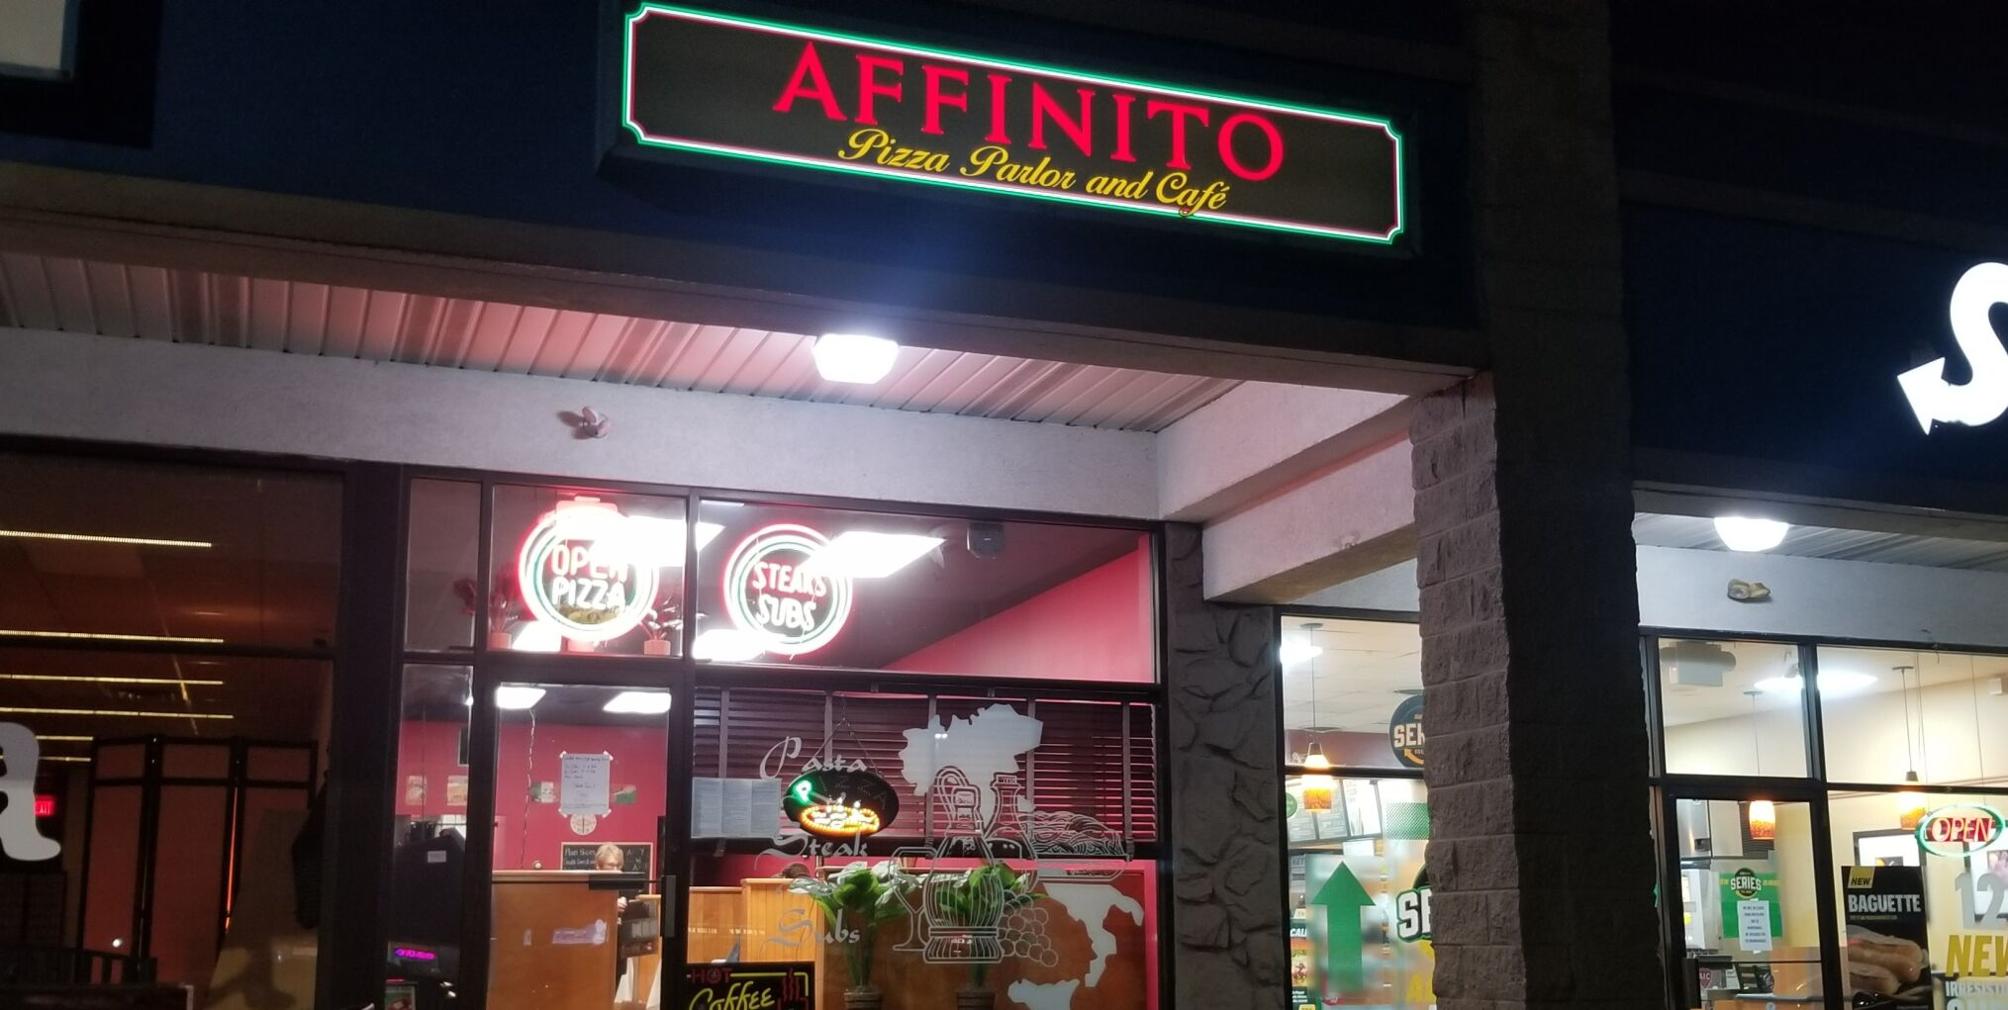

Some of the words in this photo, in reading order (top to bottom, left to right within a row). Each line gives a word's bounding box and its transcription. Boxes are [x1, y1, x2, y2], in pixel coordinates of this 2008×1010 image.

[773, 41, 1284, 181] AFFINITO
[838, 128, 953, 172] Pizza
[960, 145, 1079, 189] Parlor
[1086, 171, 1153, 199] and
[1156, 172, 1232, 217] Café
[551, 577, 626, 613] PIZZA
[756, 594, 817, 631] SUBS
[760, 736, 868, 780] Pasta
[757, 824, 868, 866] Steak
[1932, 817, 1992, 842] OPEN
[1730, 876, 1762, 890] SERIES
[1851, 878, 1871, 886] NEW
[1848, 894, 1922, 912] BAGUETTE
[762, 908, 861, 949] Subs
[690, 967, 732, 983] HOT
